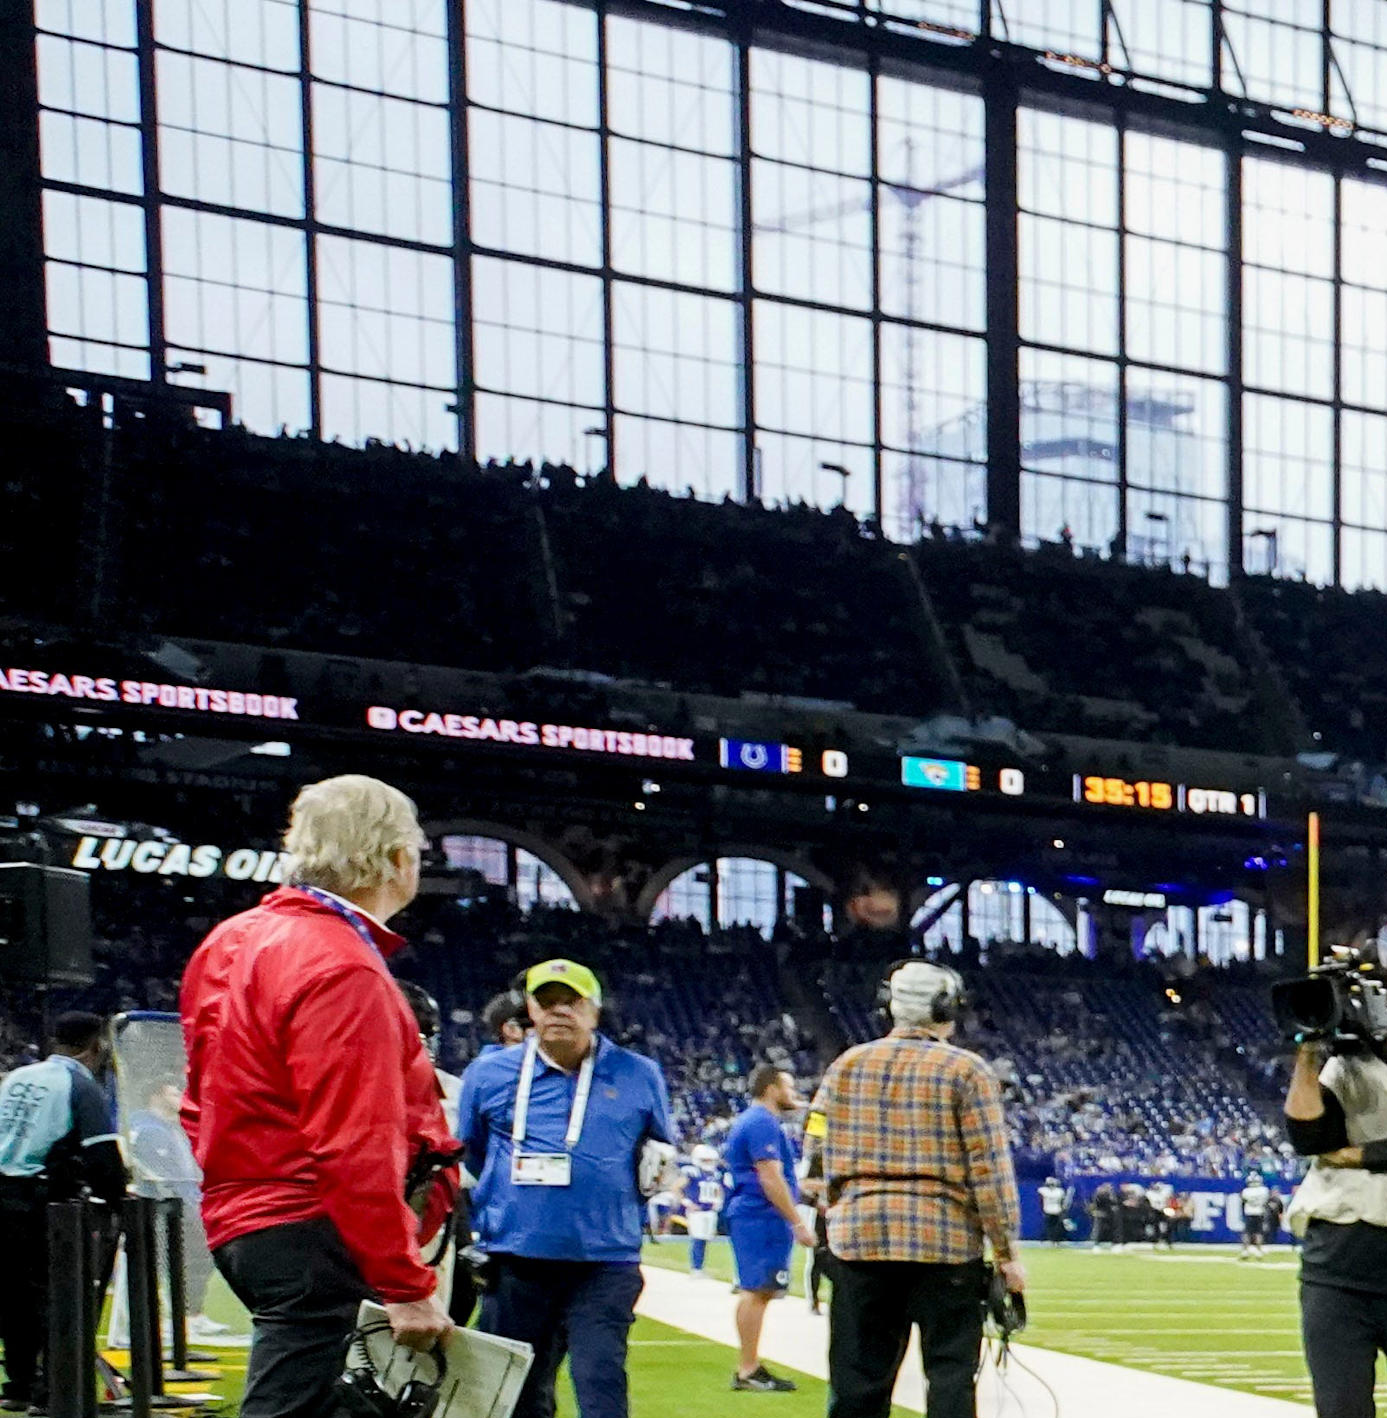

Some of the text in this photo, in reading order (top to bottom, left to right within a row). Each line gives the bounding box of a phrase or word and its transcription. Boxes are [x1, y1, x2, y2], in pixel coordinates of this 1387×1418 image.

[121, 680, 299, 720] SPORTSBOOK
[399, 710, 695, 760] CAESARS SPORTSBOOK
[72, 837, 222, 877] LUCAS
